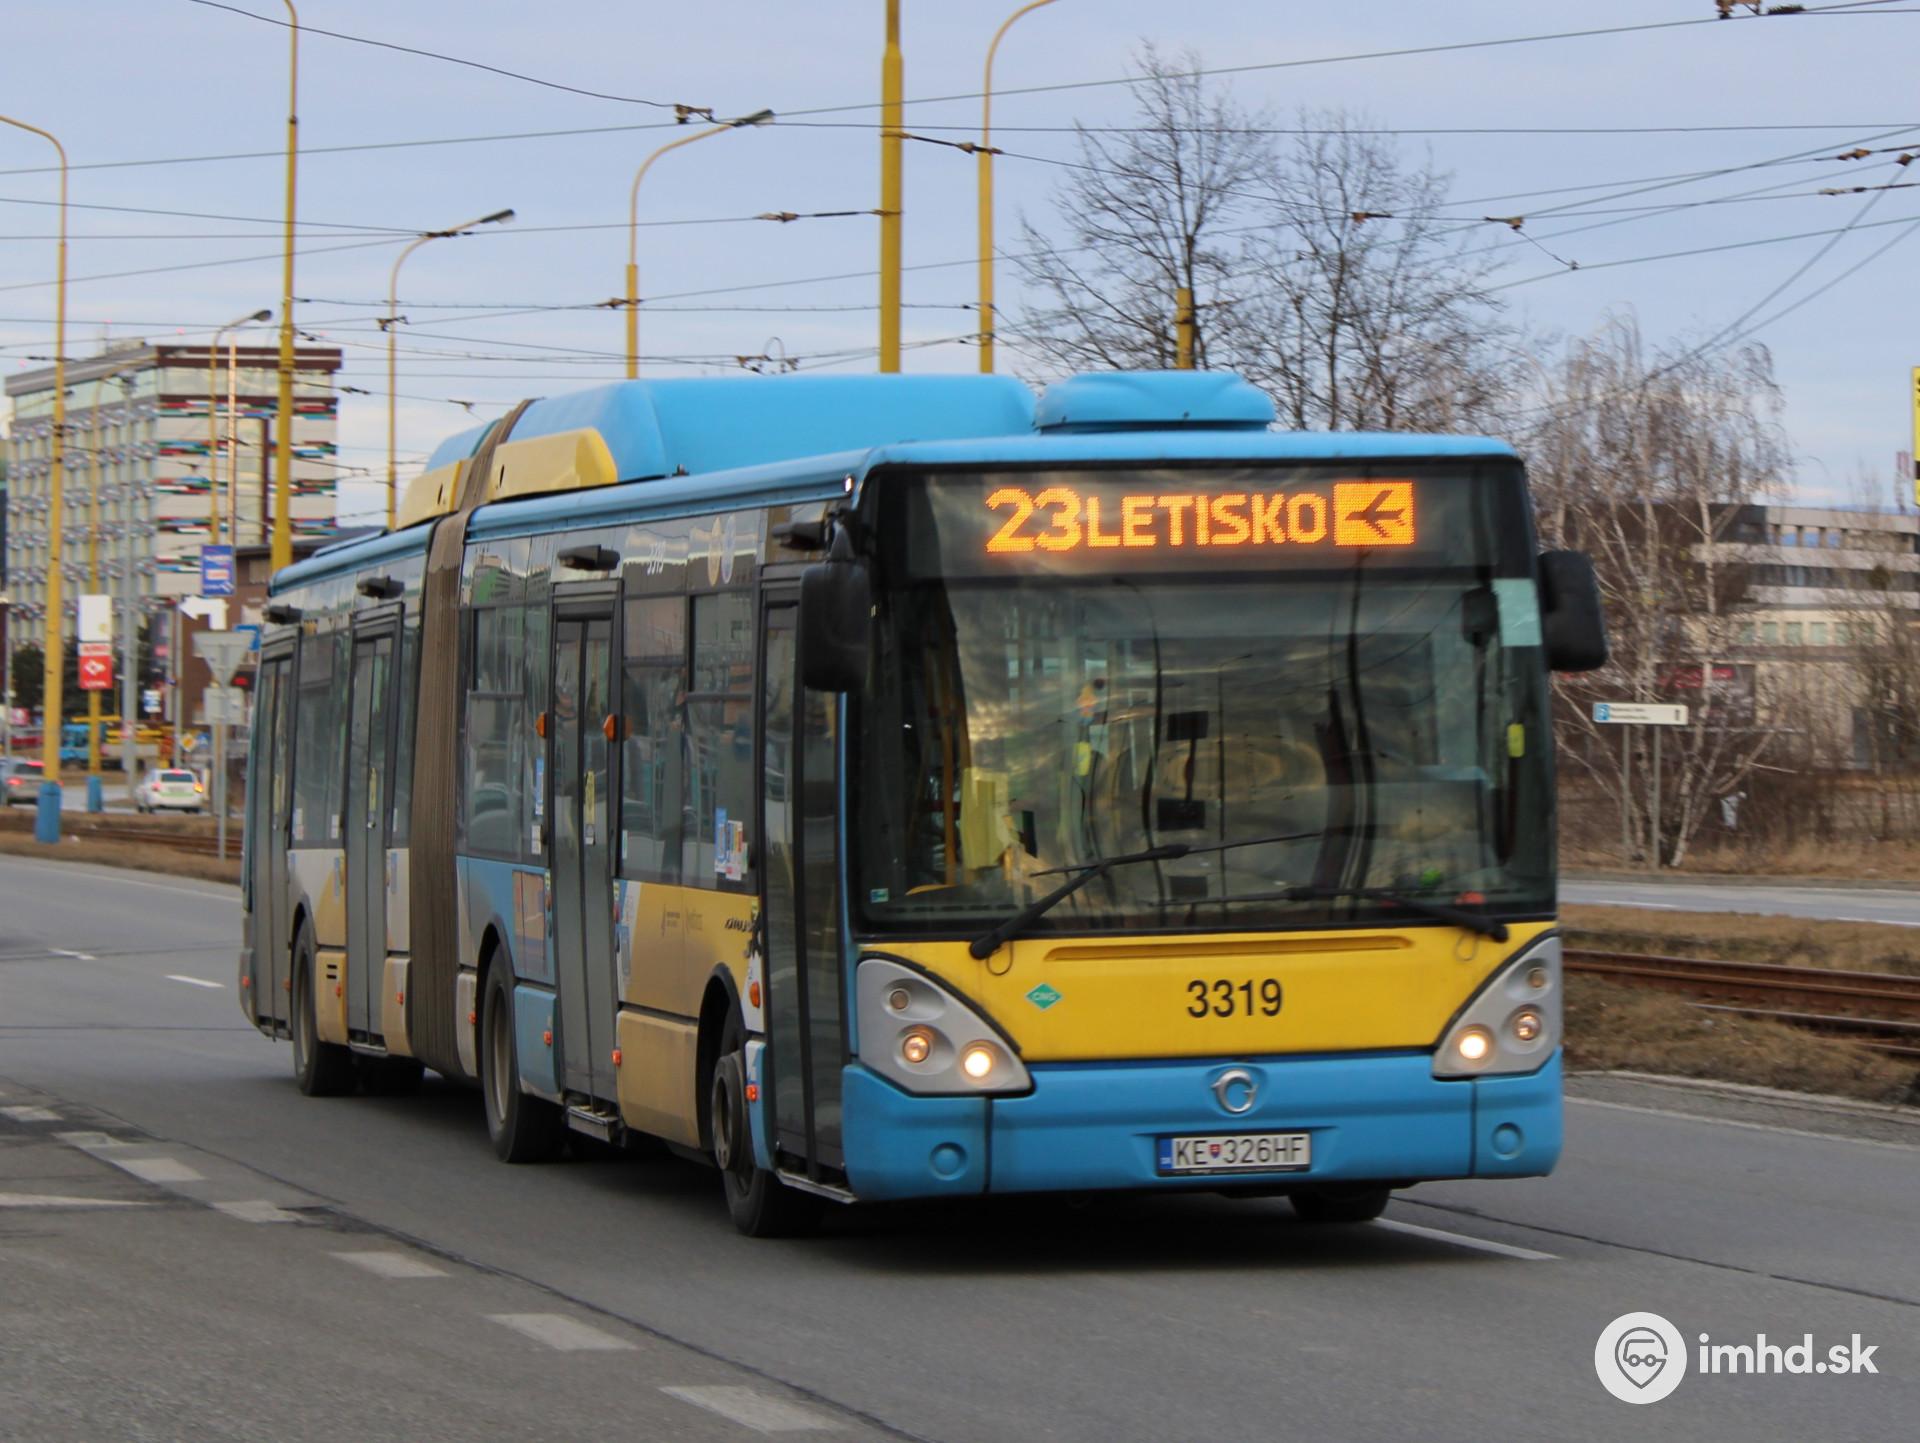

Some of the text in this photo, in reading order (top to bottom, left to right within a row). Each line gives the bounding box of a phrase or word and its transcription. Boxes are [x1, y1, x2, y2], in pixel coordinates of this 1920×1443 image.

[986, 488, 1327, 552] 23 LETISKO
[1187, 978, 1282, 1018] 3319
[1175, 1136, 1305, 1166] KE 326HF
